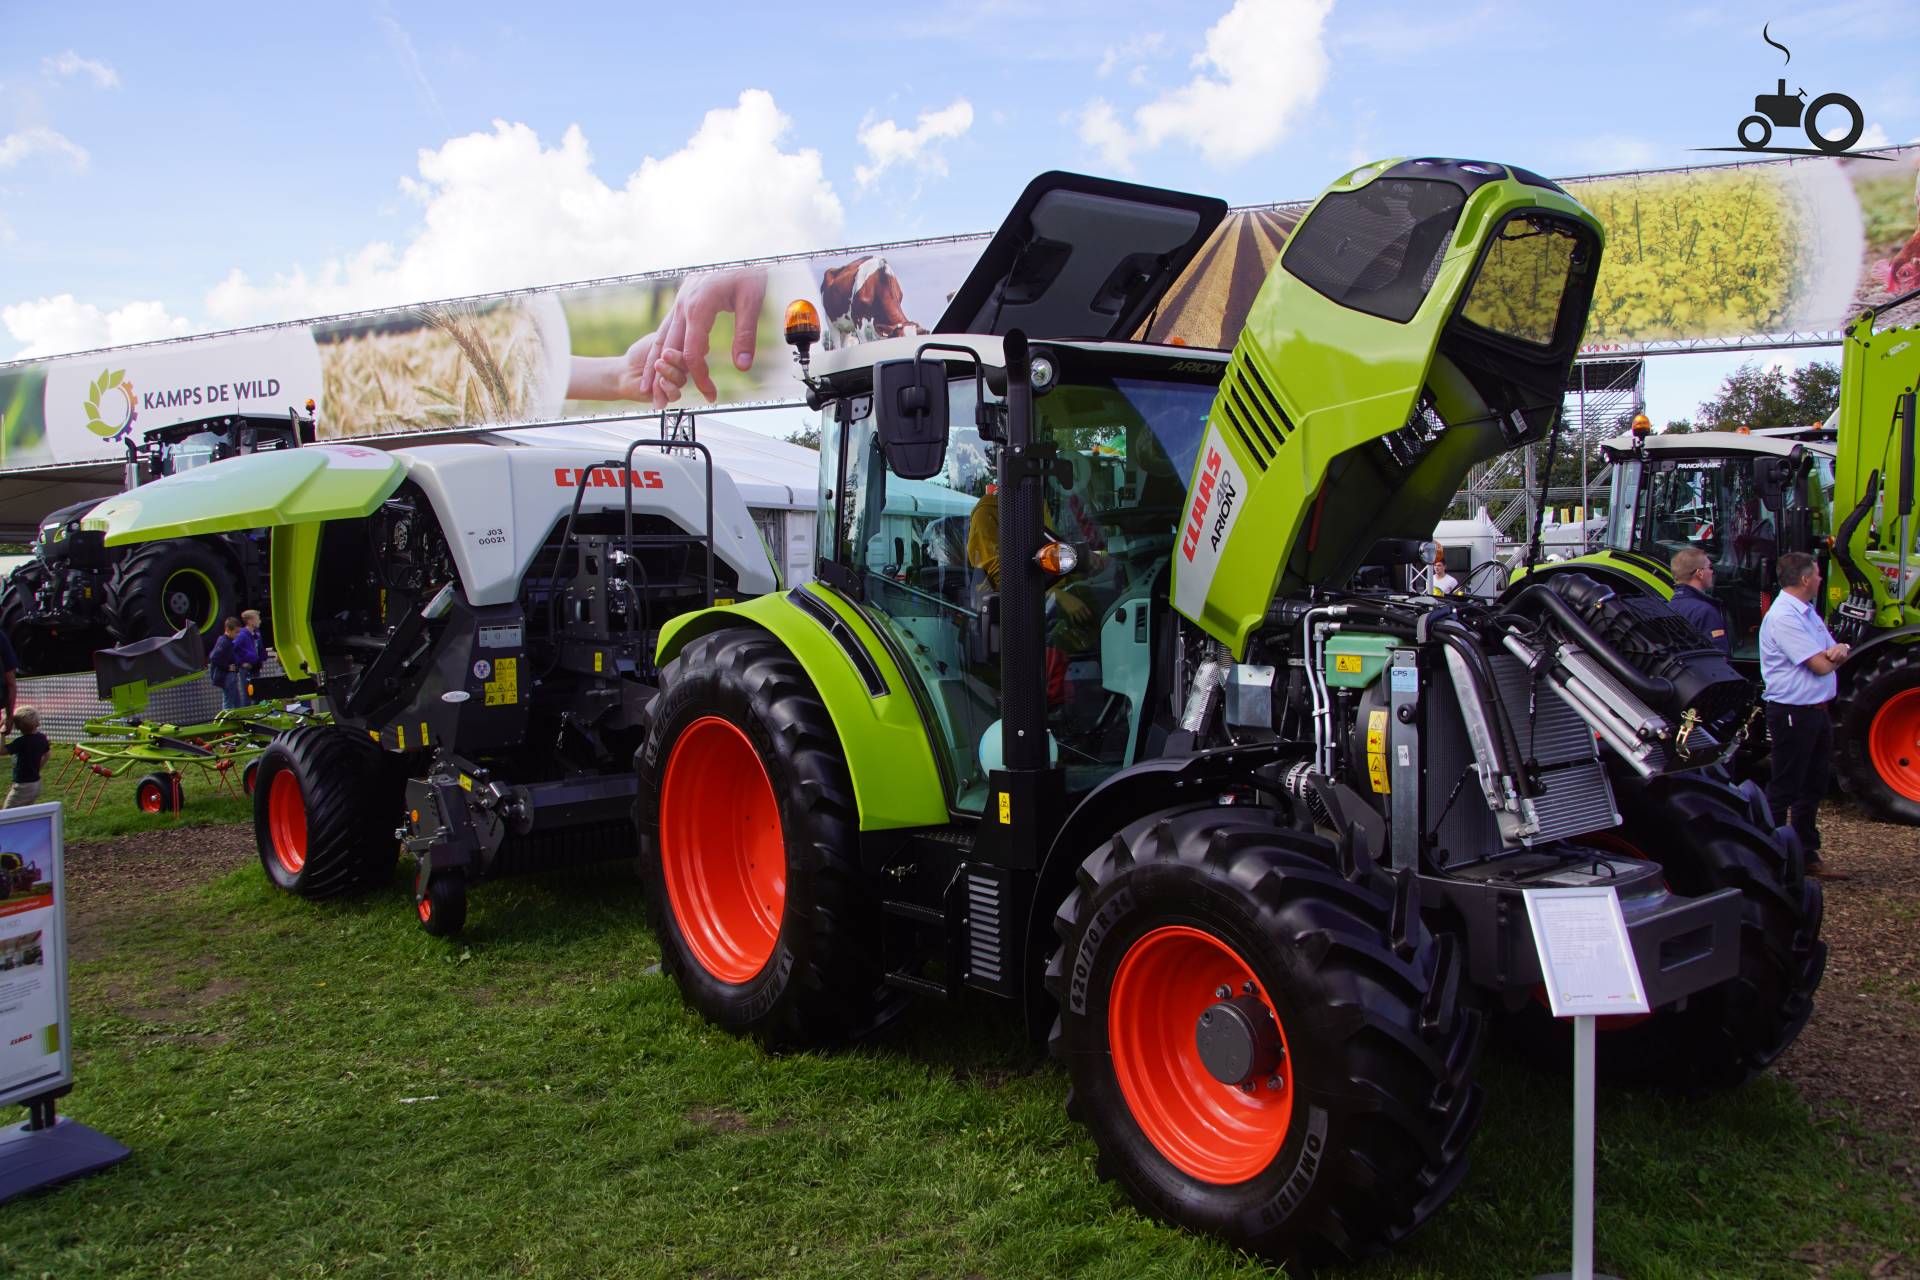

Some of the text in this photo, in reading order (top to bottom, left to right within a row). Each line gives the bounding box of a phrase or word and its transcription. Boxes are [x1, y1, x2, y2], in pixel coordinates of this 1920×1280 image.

[1169, 360, 1223, 374] ARION
[144, 378, 280, 410] KAMPS DE WILD
[554, 468, 664, 489] CLAAS
[1677, 462, 1721, 470] PANORAMIC
[1216, 470, 1231, 507] 410
[1182, 446, 1223, 564] CLAAS
[1209, 484, 1238, 553] ARION
[478, 536, 506, 545] 00021
[487, 528, 503, 537] J03
[1071, 892, 1131, 1009] 420/70 R 24
